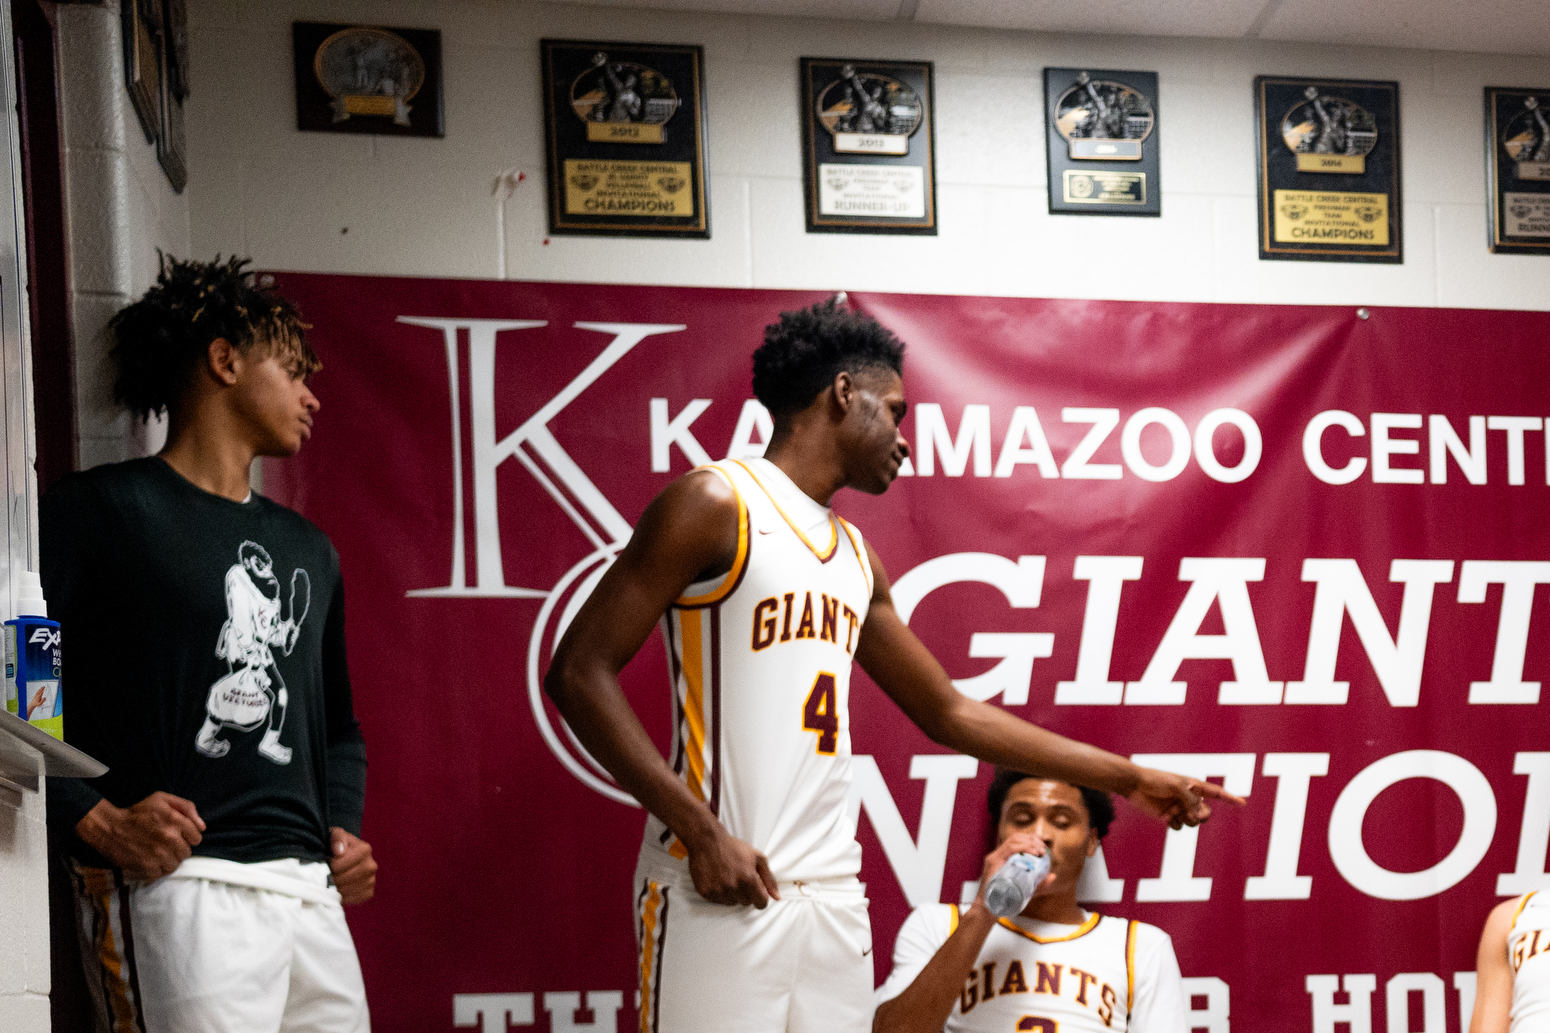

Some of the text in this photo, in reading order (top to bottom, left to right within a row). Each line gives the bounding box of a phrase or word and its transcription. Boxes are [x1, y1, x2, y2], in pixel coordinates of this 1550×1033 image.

[584, 199, 676, 212] CHAMPIONS
[834, 200, 911, 212] RUNNER-UP
[1291, 227, 1375, 240] CHAMPIONS
[650, 397, 1263, 484] KAMAZOO
[751, 590, 864, 655] GIANT
[802, 669, 839, 757] 4
[960, 959, 1117, 1027] GIANTS
